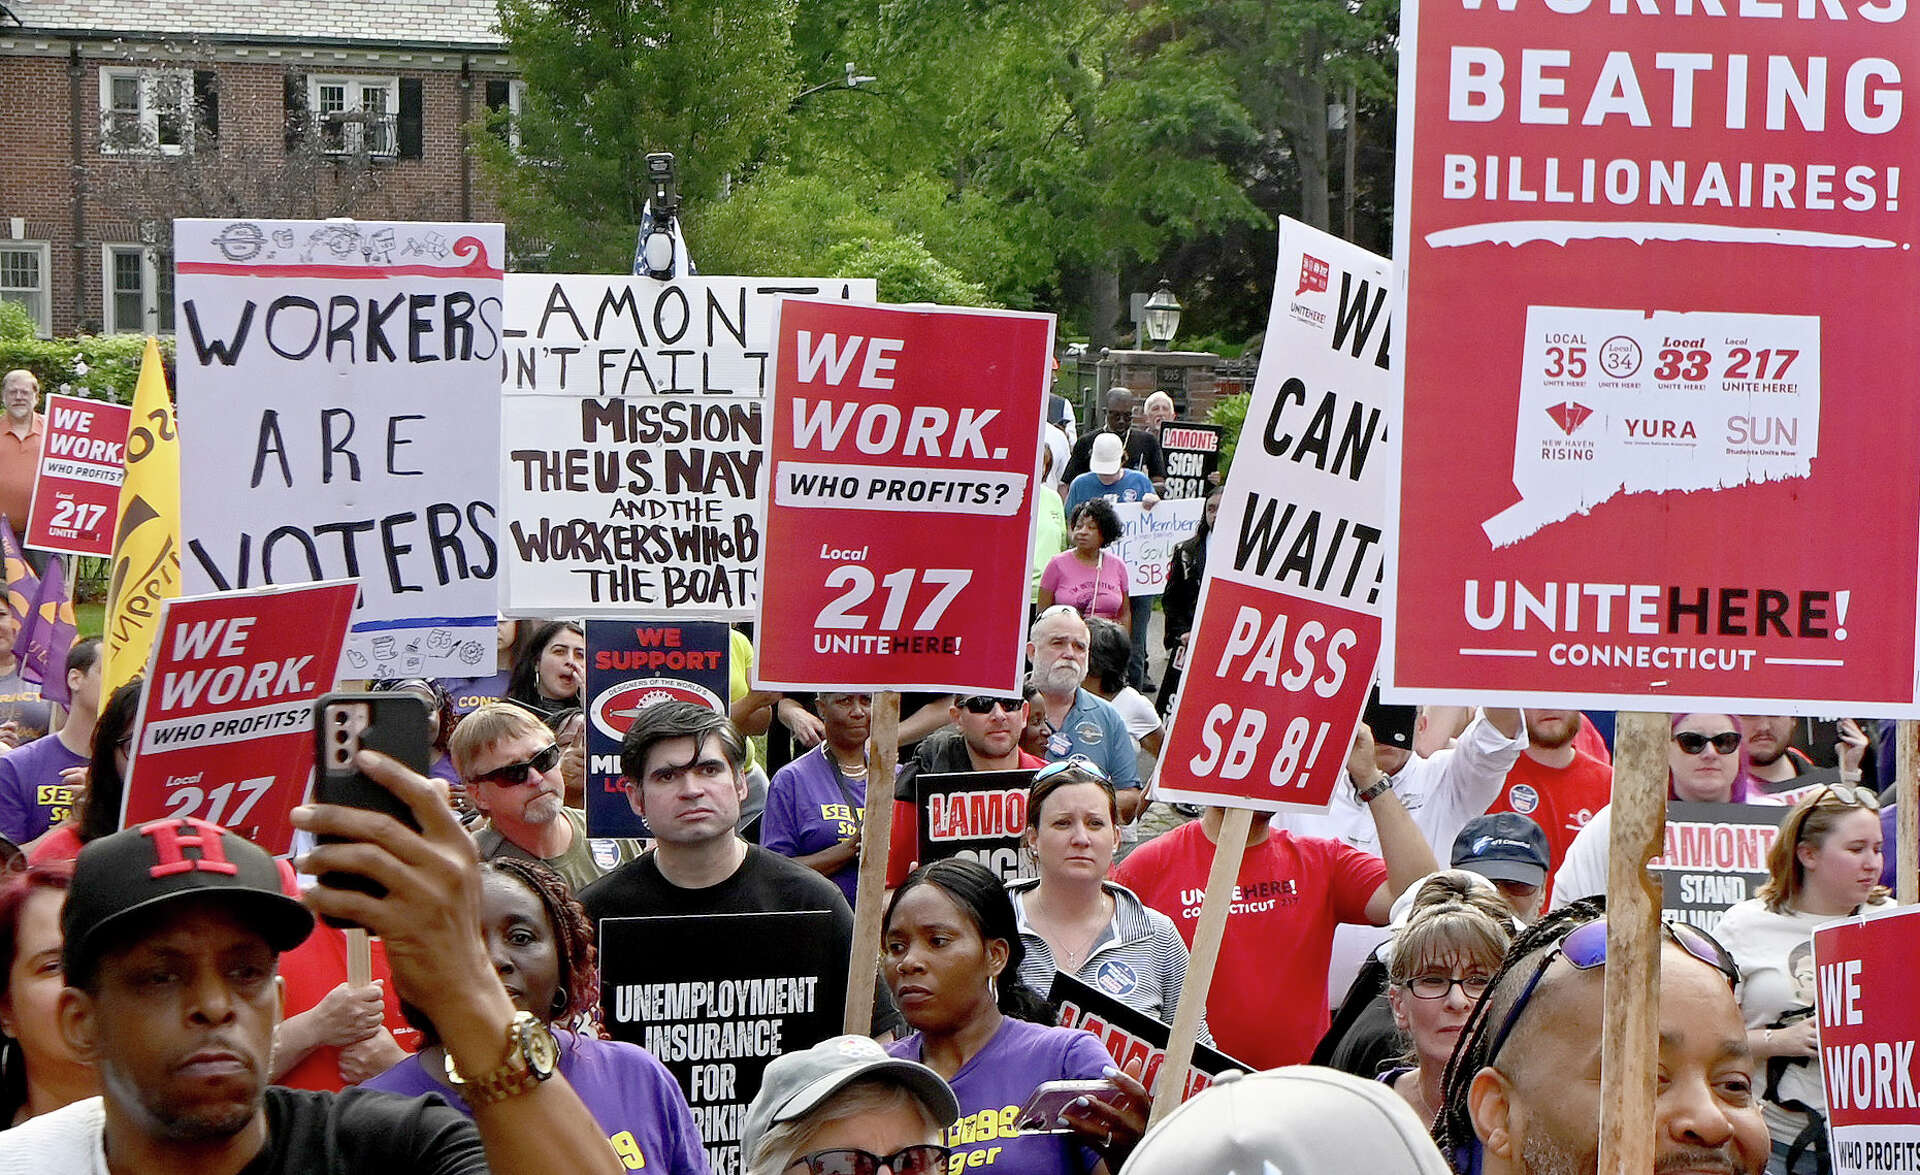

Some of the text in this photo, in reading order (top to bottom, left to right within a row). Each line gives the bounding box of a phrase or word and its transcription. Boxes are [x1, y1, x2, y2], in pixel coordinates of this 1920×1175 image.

[1448, 45, 1903, 134] BEATING
[1443, 154, 1900, 212] BILLIONAIRES!
[183, 293, 503, 366] WORKERS
[503, 282, 820, 347] AMON
[1545, 334, 1586, 345] LOCAL
[1608, 344, 1633, 352] Local
[1662, 337, 1705, 348] Local
[1724, 337, 1748, 346] Local
[599, 348, 733, 396] FAIL
[796, 330, 904, 390] WE
[1544, 347, 1587, 378] 35
[1608, 353, 1632, 370] 34
[1653, 349, 1712, 381] 33
[1723, 348, 1800, 380] 217
[1722, 382, 1798, 394] UNITE HERE!
[53, 407, 94, 433] WE
[581, 398, 762, 444] MISSION
[792, 397, 1009, 460] WORK.
[1263, 377, 1387, 482] CAN'
[1625, 419, 1697, 439] YURA
[1726, 416, 1798, 445] SUN
[51, 433, 124, 464] WORK.
[251, 408, 426, 488] ARE
[1163, 429, 1218, 451] LAMONT:
[1541, 448, 1594, 461] RISING
[48, 462, 124, 482] WHO PROFITS?
[511, 450, 589, 492] THE
[1167, 452, 1204, 477] SIGN
[790, 473, 1010, 505] WHO PROFITS?
[1164, 478, 1185, 499] SB
[50, 500, 107, 531] 217
[610, 497, 723, 522] AND THE
[188, 501, 498, 608] VOTERS
[510, 517, 673, 564] WORKERS
[820, 544, 869, 561] Local
[571, 564, 655, 602] THE
[1136, 564, 1161, 585] SB
[814, 565, 973, 631] 217
[1464, 580, 1850, 641] UNITEHERE!
[174, 617, 257, 662] WE
[636, 627, 682, 647] WE
[814, 634, 962, 656] UNITEHERE!
[1215, 605, 1358, 698] PASS
[595, 651, 722, 670] SUPPORT
[1549, 643, 1756, 671] CONNECTICUT
[161, 655, 315, 711] WORK.
[608, 679, 648, 696] DESIGNERS
[154, 707, 311, 745] WHO PROFITS?
[1190, 703, 1267, 780] SB
[1269, 716, 1331, 789] 8!
[166, 772, 204, 787] Local
[165, 775, 276, 827] 217
[930, 791, 1028, 840] LAMO
[140, 817, 238, 878] H
[1681, 875, 1746, 905] STAND
[1182, 899, 1275, 919] COCTICUT
[616, 976, 818, 1023] UNEMPLOYMENT
[1820, 959, 1863, 1028] WE
[645, 1019, 783, 1062] INSURANCE
[691, 1063, 736, 1102] FOR
[1826, 1040, 1920, 1110] WORK.
[1838, 1141, 1861, 1171] WHO
